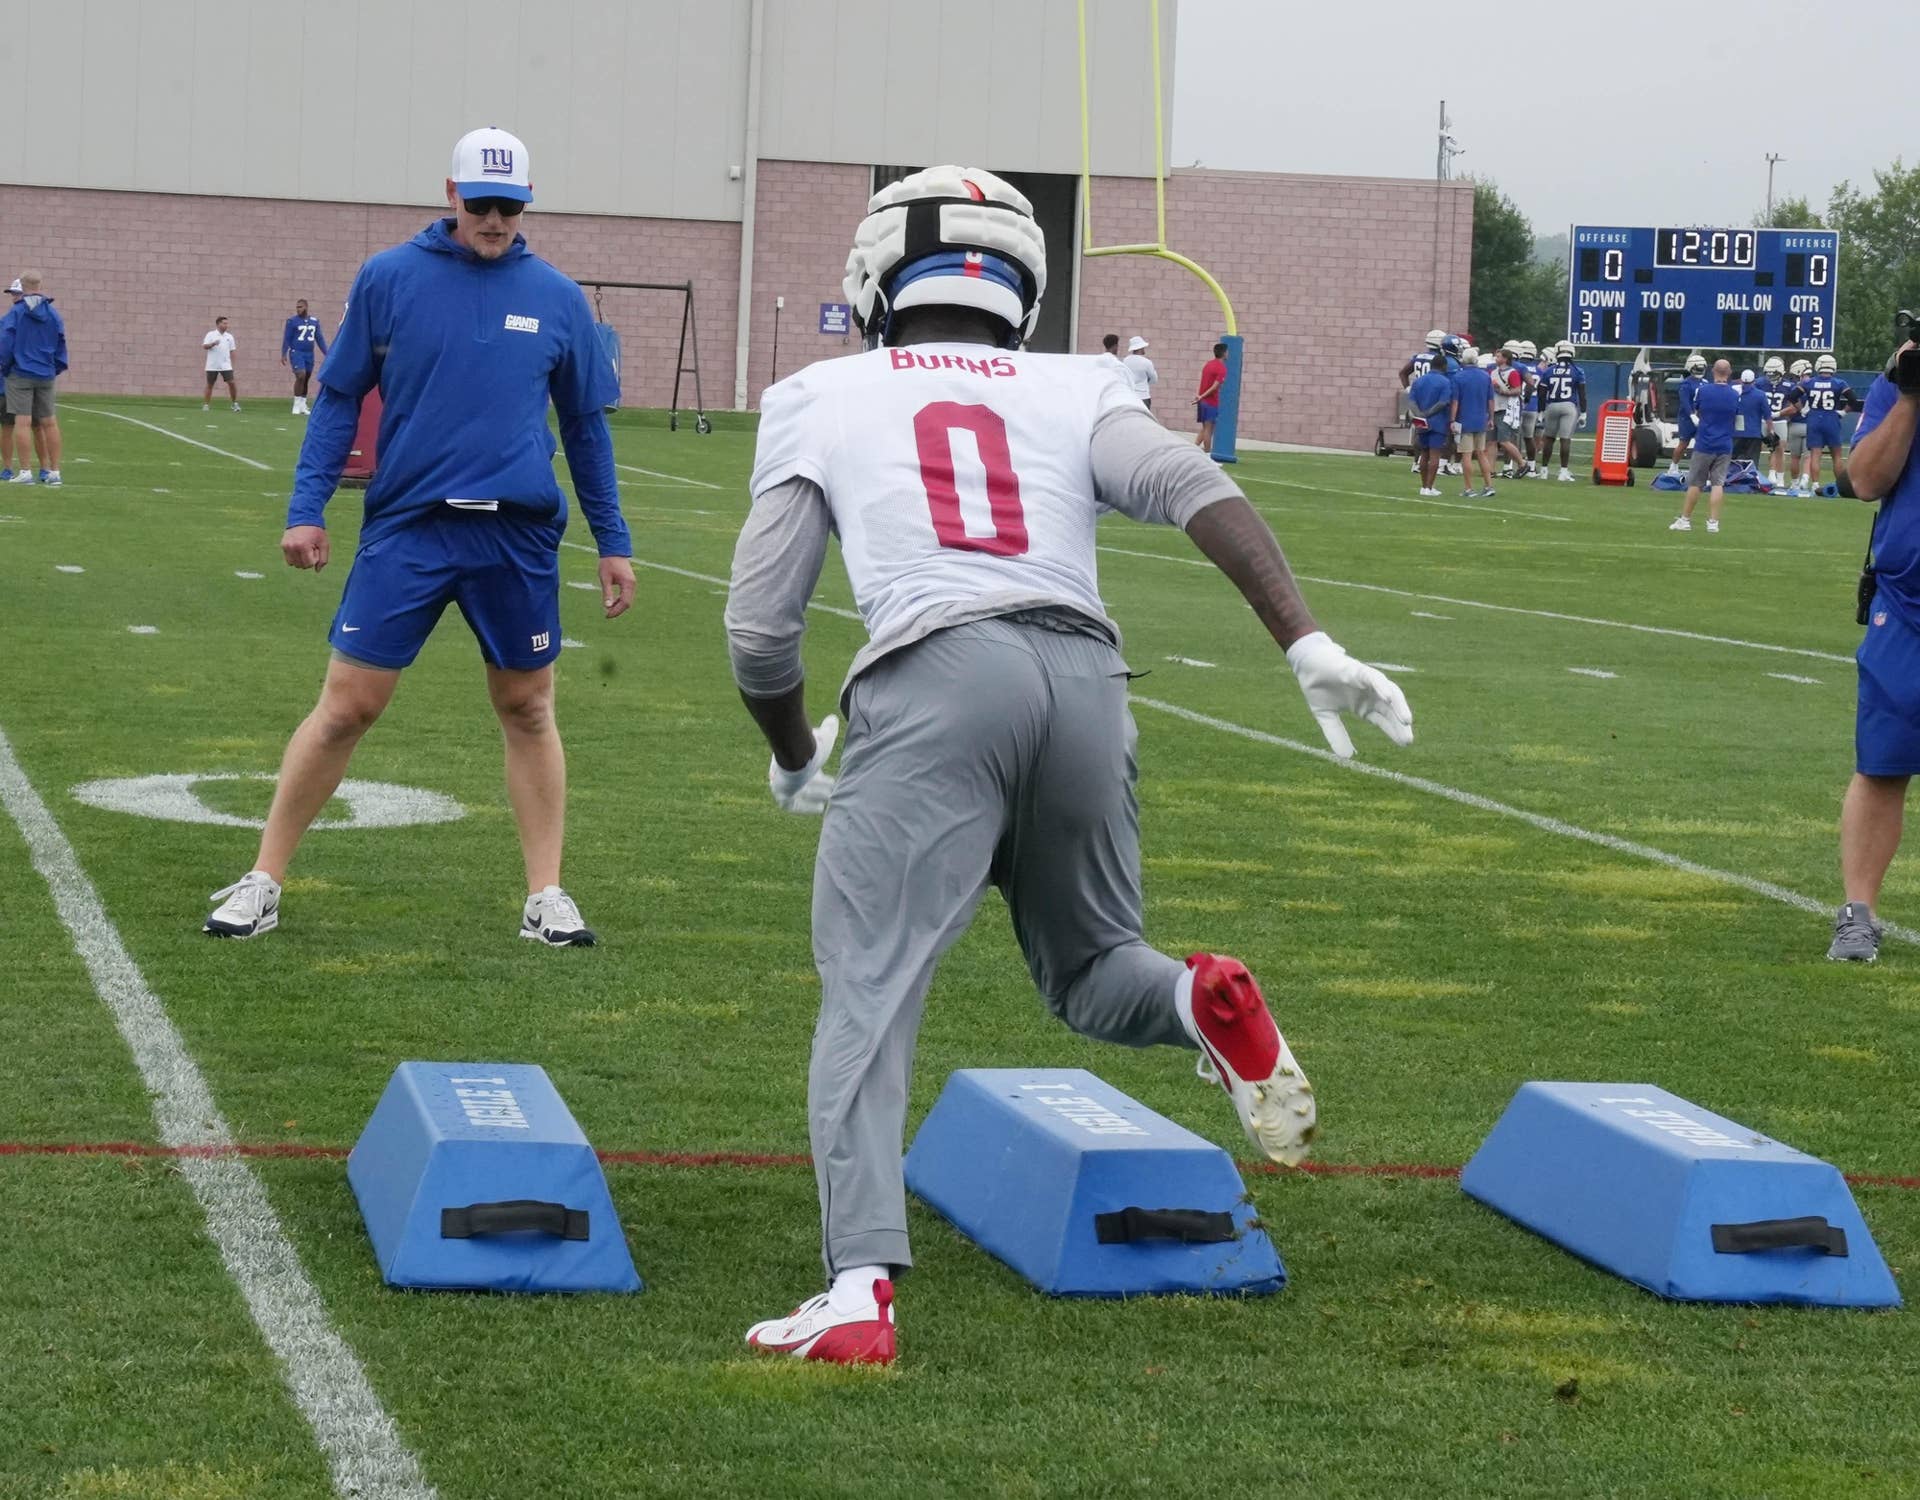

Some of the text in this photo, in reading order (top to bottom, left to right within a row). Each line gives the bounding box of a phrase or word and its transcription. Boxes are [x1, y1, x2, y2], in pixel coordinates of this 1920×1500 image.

[480, 147, 513, 176] ny
[1579, 233, 1628, 244] OFFENSE
[1671, 231, 1752, 265] 12:00
[1785, 238, 1833, 249] DEFENSE
[1604, 249, 1623, 281] 0
[1809, 254, 1828, 286] 0
[1579, 289, 1625, 308] DOWN
[1641, 291, 1686, 309] TO GO
[1716, 293, 1772, 312] BALL ON
[1789, 295, 1820, 313] QTR
[504, 314, 540, 334] GIANTS
[1581, 311, 1593, 330] 3
[1615, 312, 1621, 339] 1
[1795, 316, 1801, 344] 1
[1812, 316, 1823, 336] 3
[297, 325, 316, 342] 73
[1571, 332, 1601, 345] T.O.L.
[1801, 338, 1831, 351] T.O.L.
[889, 348, 1017, 379] BURNS
[1549, 377, 1573, 399] 75
[1810, 389, 1835, 411] 76
[912, 400, 1029, 557] 0
[531, 631, 550, 652] ny
[455, 1088, 530, 1129] AGILE
[1036, 1096, 1152, 1136] AGILE
[1620, 1108, 1755, 1149] AGILE
